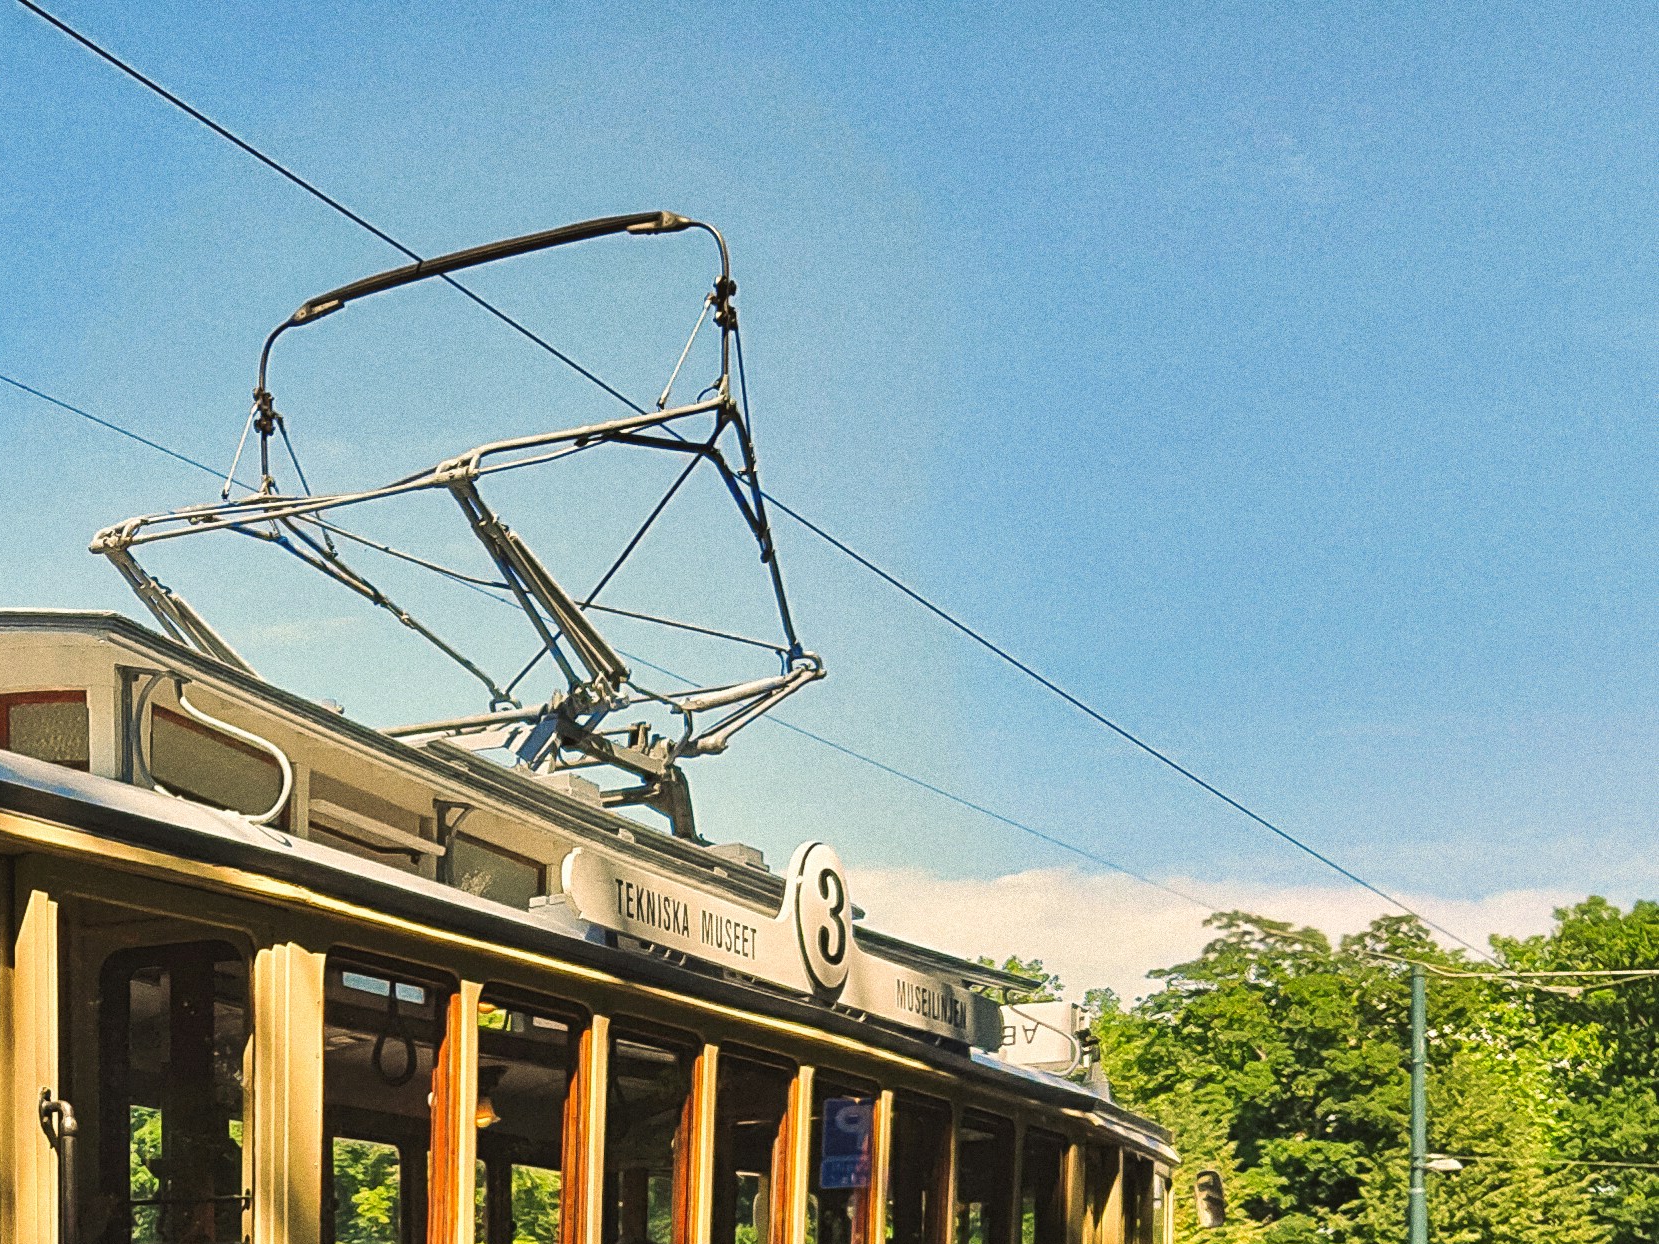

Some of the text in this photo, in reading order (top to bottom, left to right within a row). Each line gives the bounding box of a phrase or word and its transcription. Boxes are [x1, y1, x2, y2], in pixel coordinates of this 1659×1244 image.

[615, 878, 757, 960] TEKNISKA MUSEET
[818, 868, 846, 965] 3
[896, 978, 966, 1029] MUSEILINJEN
